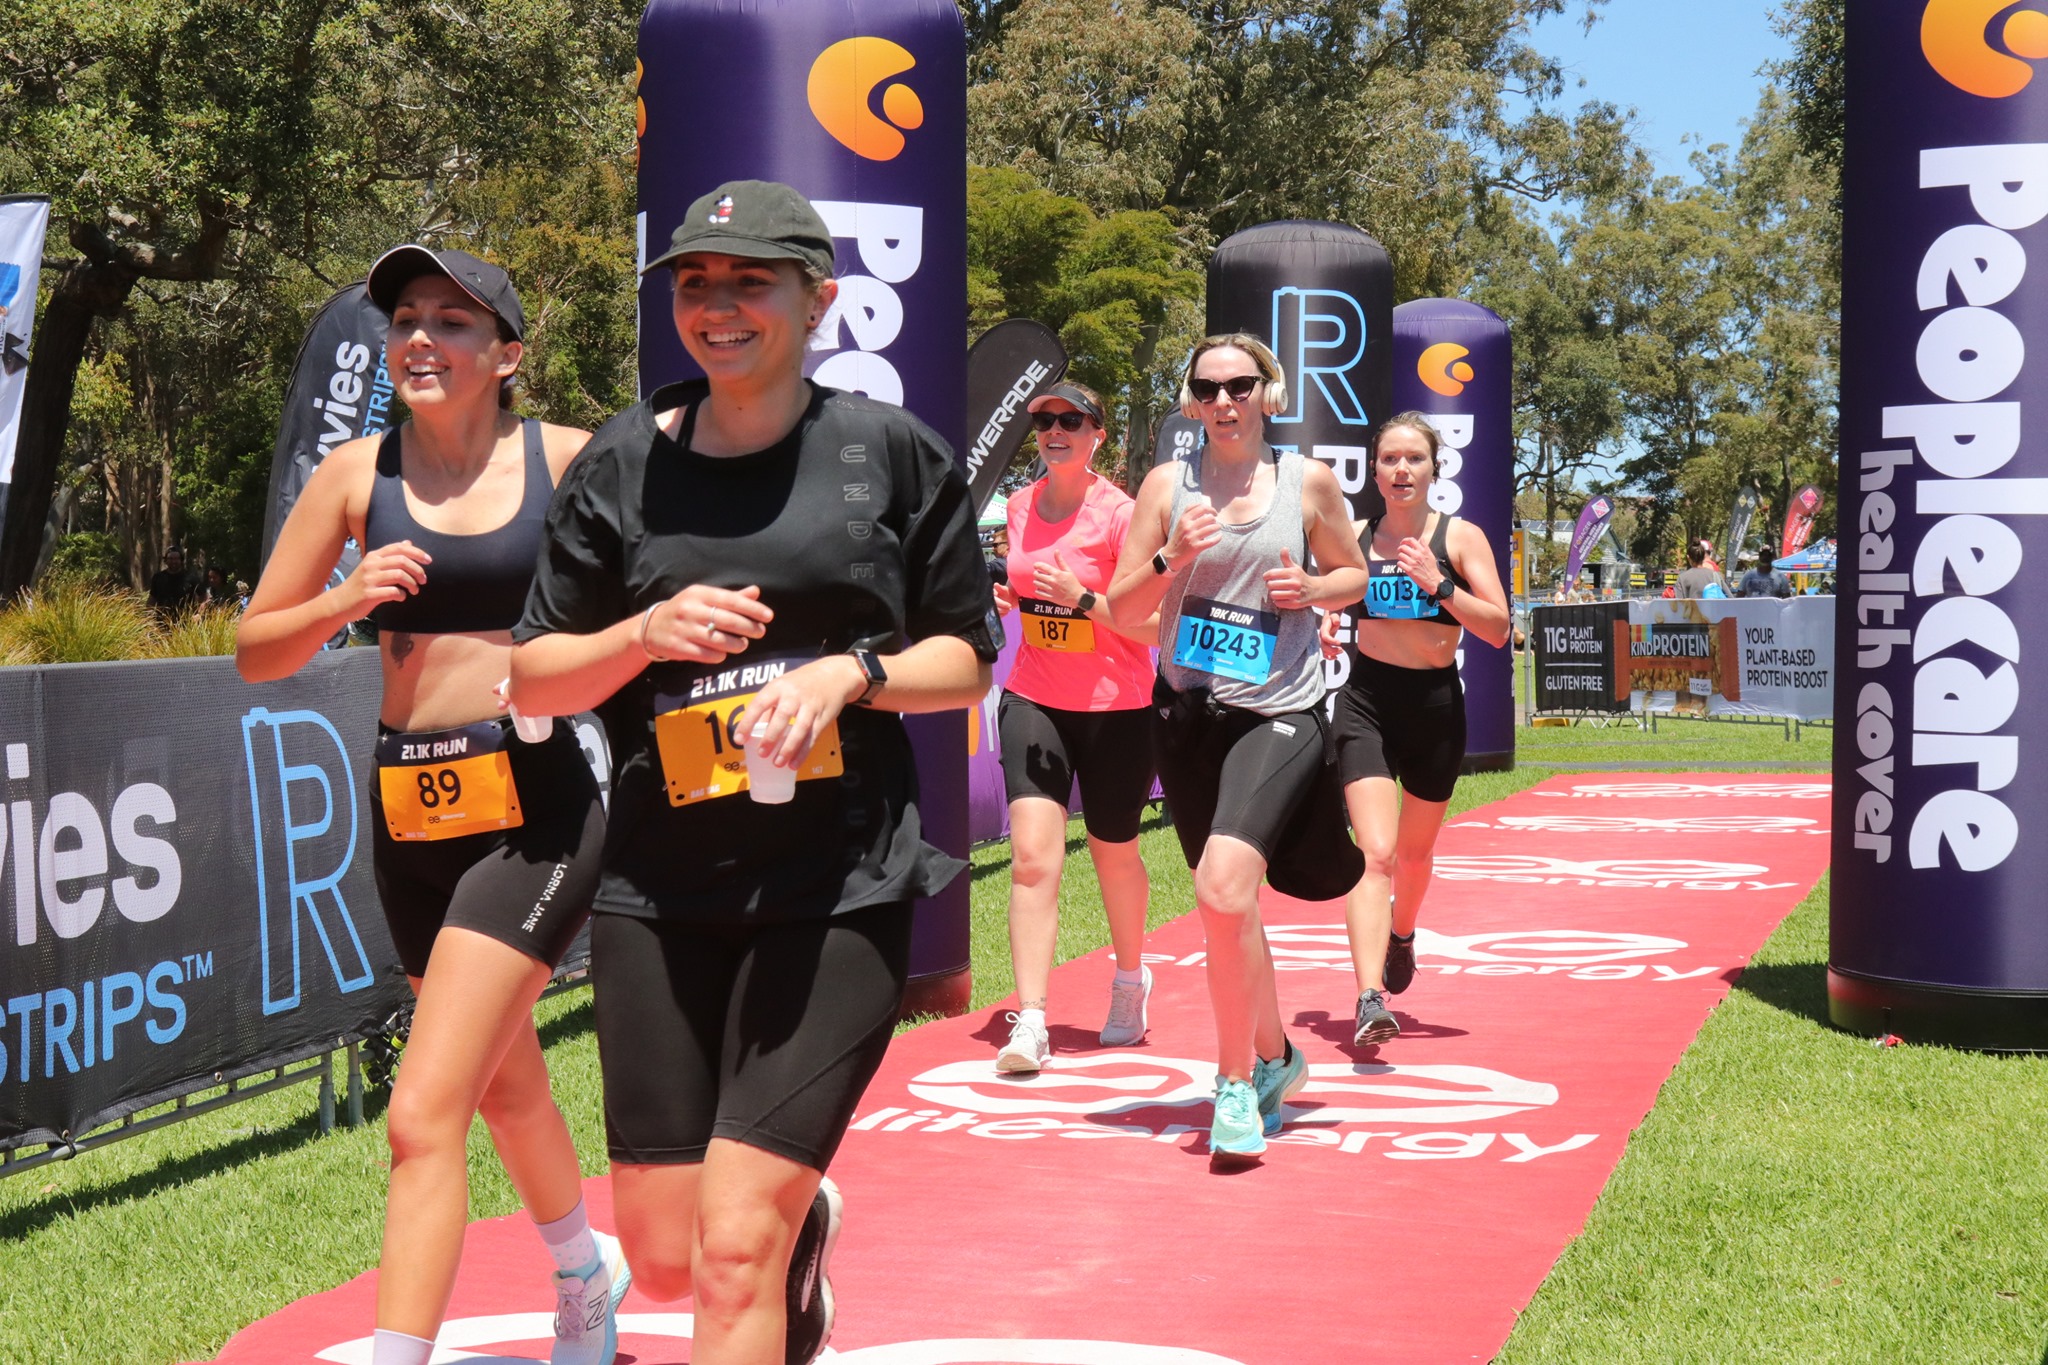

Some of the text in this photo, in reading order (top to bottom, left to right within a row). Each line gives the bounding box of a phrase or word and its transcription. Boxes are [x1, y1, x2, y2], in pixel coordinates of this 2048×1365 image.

[1881, 143, 2048, 872] Peoplecare
[1054, 607, 1073, 616] RUN
[1227, 611, 1254, 625] RUN
[1039, 619, 1070, 641] 187
[1190, 622, 1261, 660] 10243
[1544, 627, 1567, 653] 11G
[1569, 626, 1594, 640] PLANT
[1745, 627, 1774, 644] YOUR
[1569, 640, 1602, 654] PROTEIN
[1746, 649, 1815, 667] PLANT-BASED
[1854, 449, 1912, 864] health cover
[691, 662, 786, 699] 21.1K RUN
[1545, 675, 1603, 691] GLUTEN FREE
[1747, 669, 1828, 689] PROTEIN BOOST
[401, 737, 468, 760] 21.1K RUN
[417, 769, 461, 808] 89
[0, 743, 182, 946] ies
[540, 863, 568, 901] LORNA
[521, 902, 545, 933] JANE
